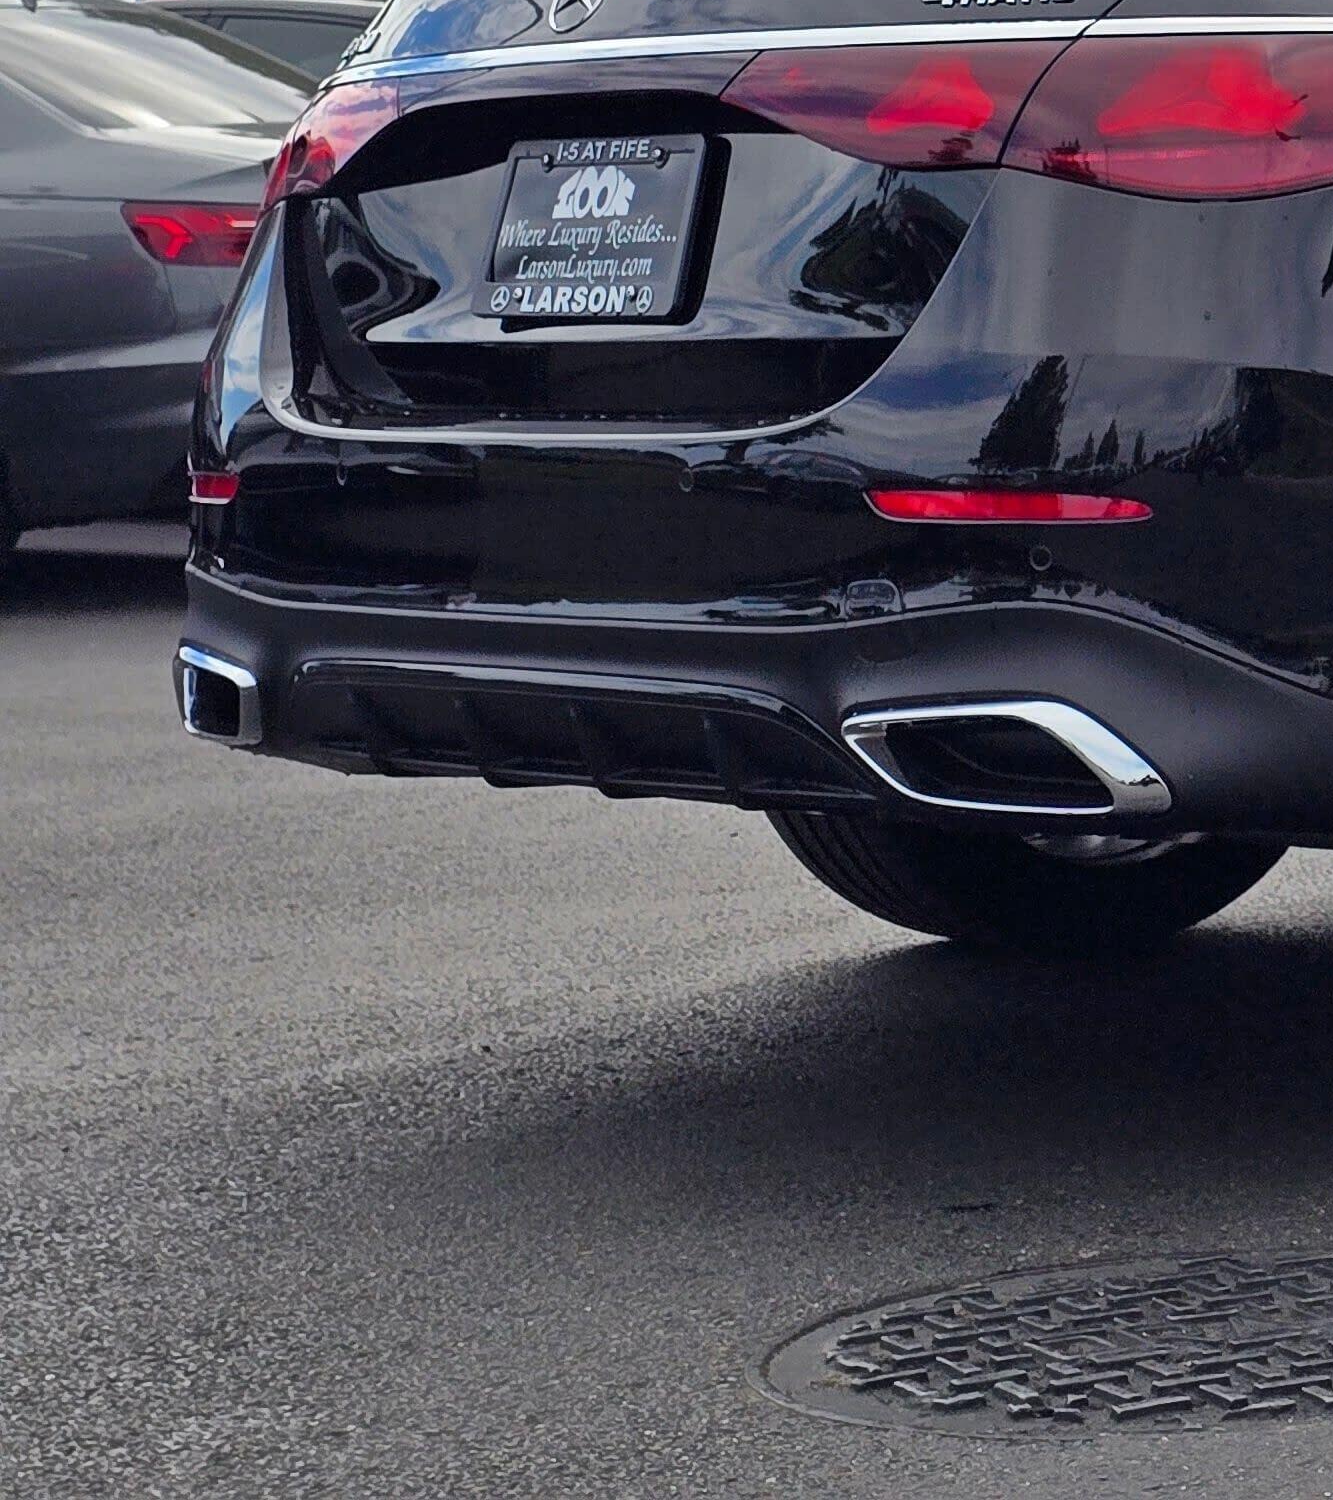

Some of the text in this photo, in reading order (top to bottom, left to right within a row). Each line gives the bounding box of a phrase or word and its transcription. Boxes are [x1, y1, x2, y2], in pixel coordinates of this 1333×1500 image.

[556, 139, 650, 161] I-5 AT FIFE
[500, 214, 678, 256] Where Luxury Resides...
[515, 253, 652, 284] LarsonLuxury.com
[519, 285, 627, 314] LARSON
